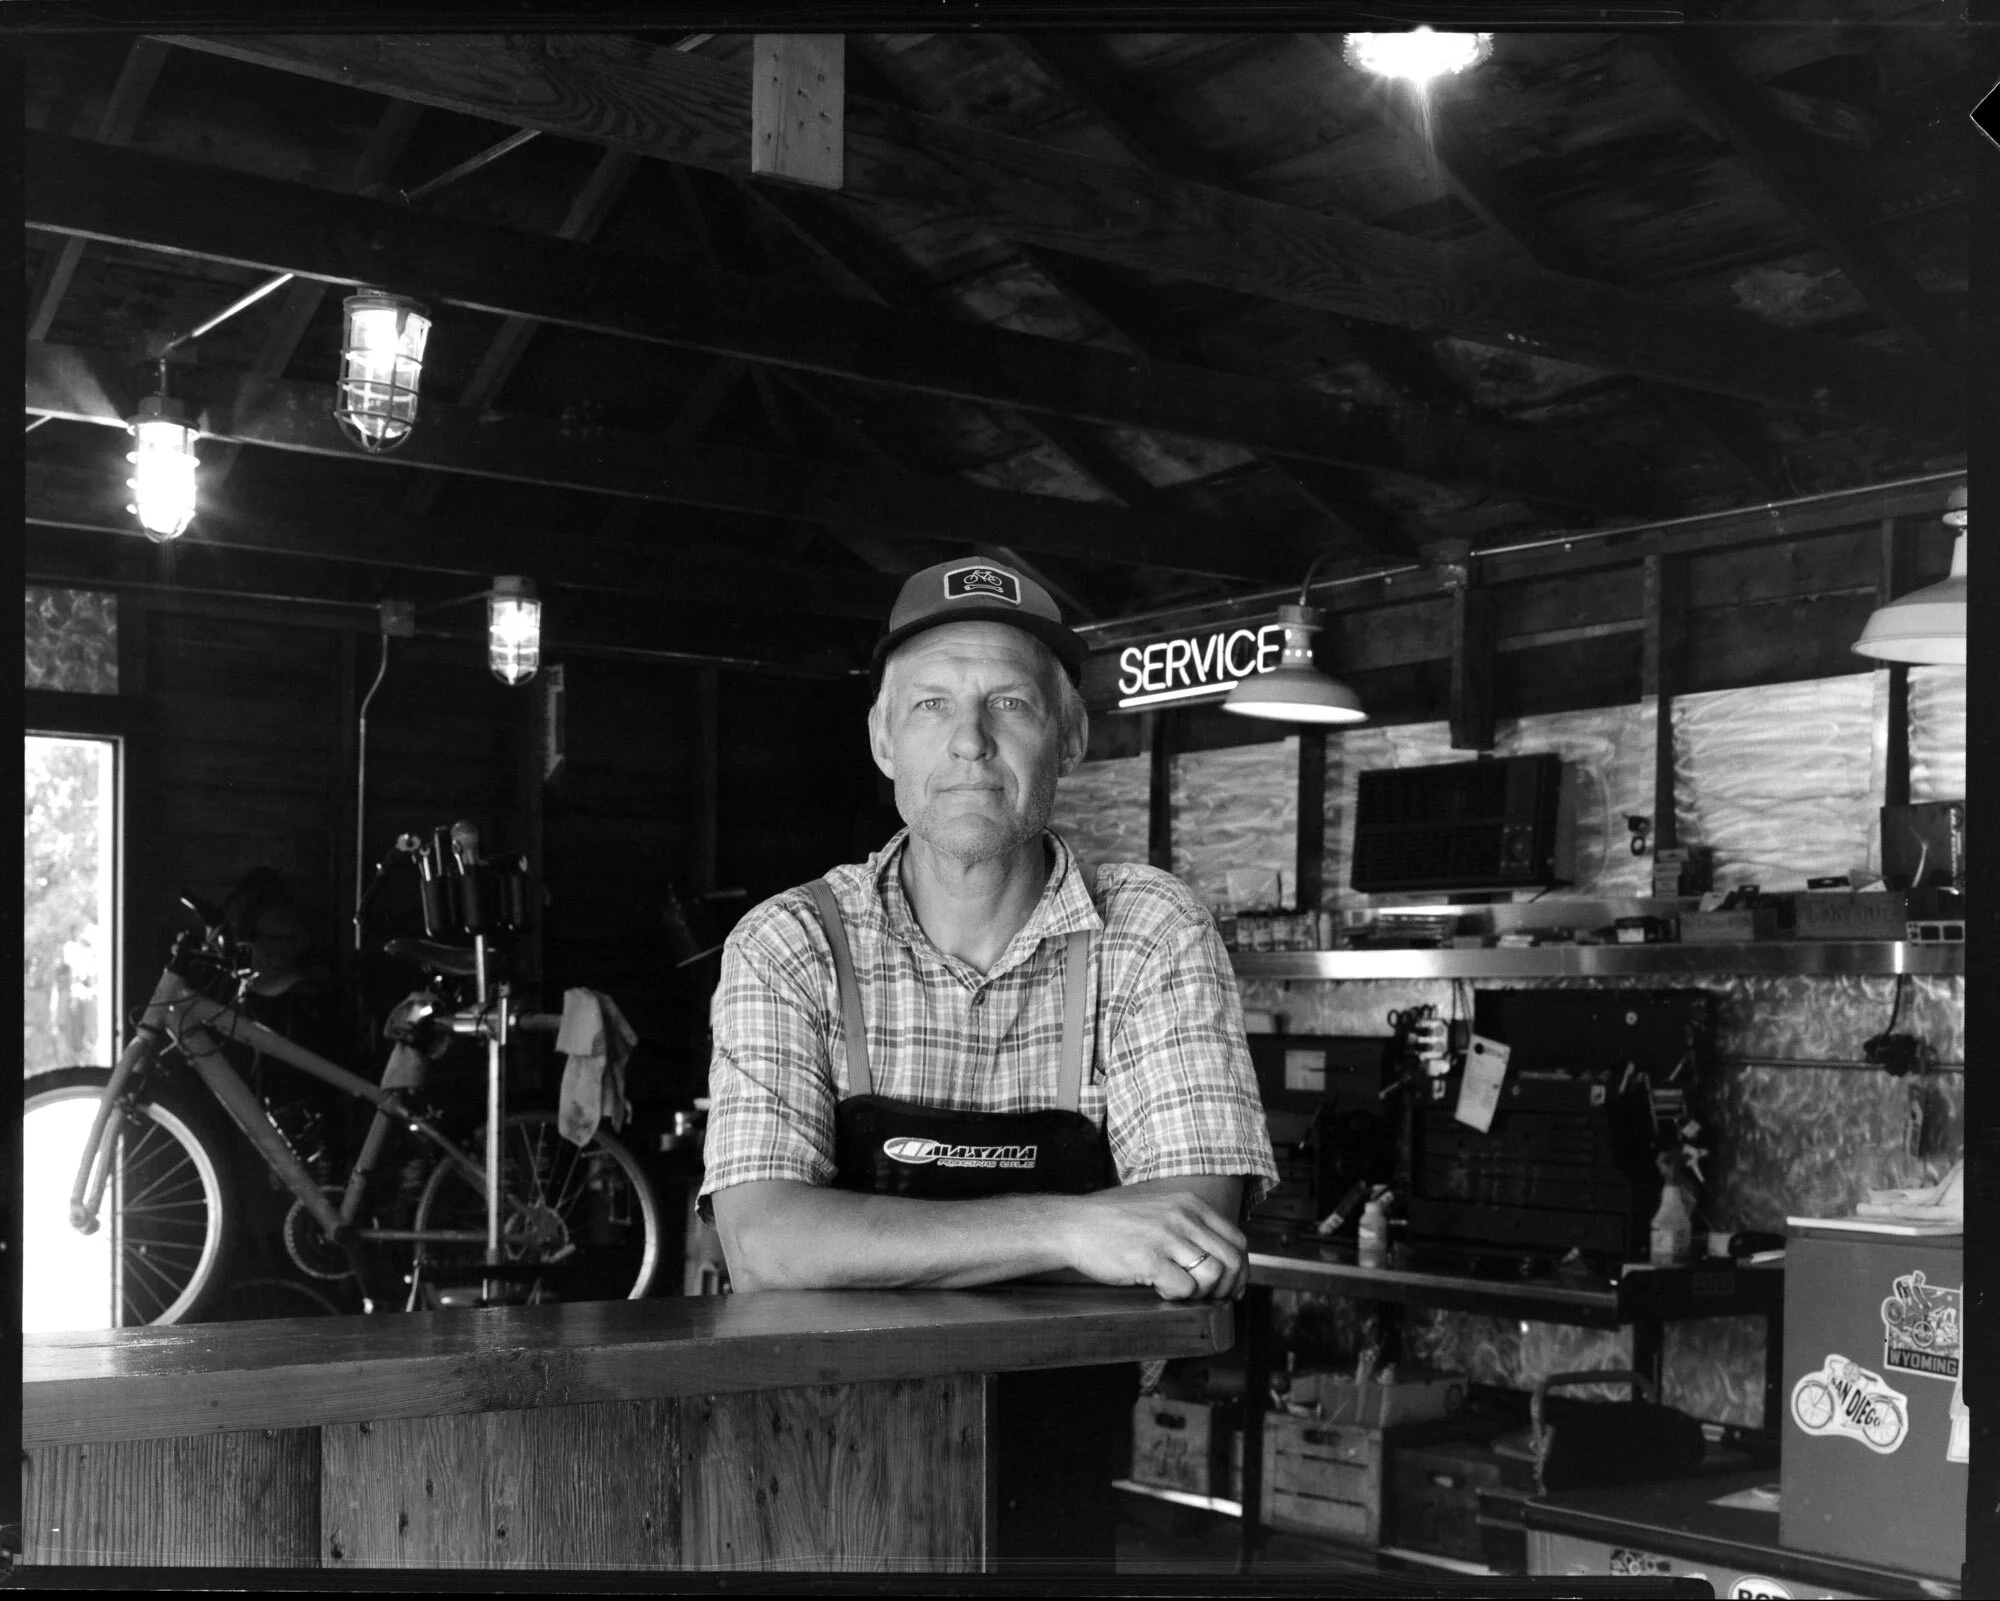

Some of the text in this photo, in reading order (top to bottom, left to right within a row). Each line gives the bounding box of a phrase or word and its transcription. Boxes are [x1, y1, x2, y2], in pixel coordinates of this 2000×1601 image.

[1118, 624, 1280, 695] SERVICE
[1890, 1349, 1957, 1375] WYOMING
[1831, 1377, 1881, 1427] SAN DIEGO
